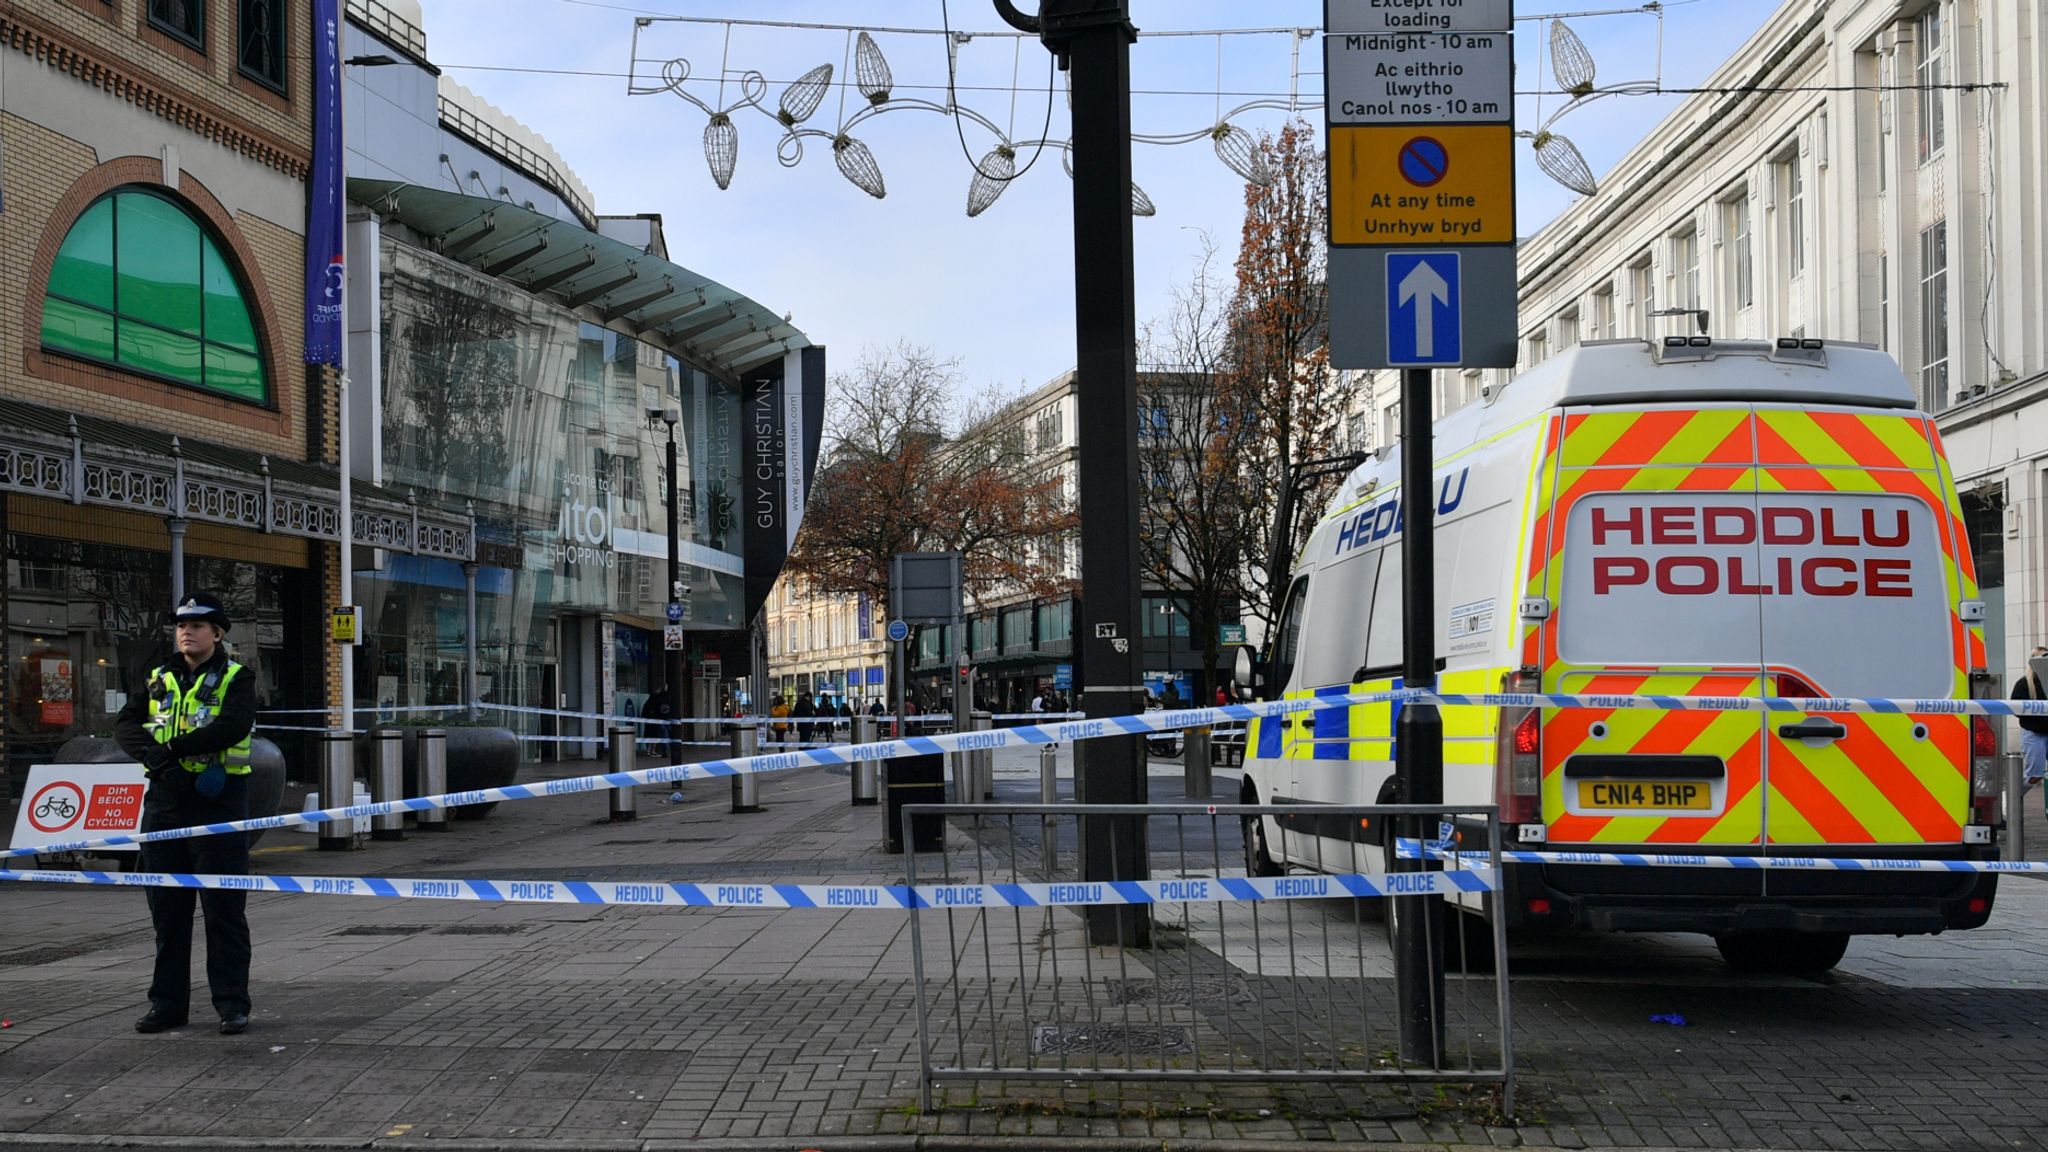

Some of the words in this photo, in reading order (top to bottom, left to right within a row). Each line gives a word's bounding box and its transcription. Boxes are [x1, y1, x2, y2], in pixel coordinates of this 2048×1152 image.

[1385, 13, 1451, 28] loading
[1346, 36, 1426, 52] Midnight
[1441, 35, 1462, 49] 10
[1466, 37, 1493, 49] am
[1375, 63, 1398, 77] Ac
[1404, 62, 1464, 77] eithrio
[1386, 81, 1453, 98] llwytho
[1341, 101, 1395, 116] Canol
[1401, 103, 1432, 115] nos
[1446, 100, 1467, 114] 10
[1472, 102, 1498, 114] am
[1371, 193, 1391, 208] At
[1398, 196, 1429, 211] any
[1436, 193, 1476, 208] time
[1364, 219, 1434, 236] Unrhyw
[1441, 218, 1481, 235] bryd
[755, 378, 773, 481] CHRISTIAN
[776, 428, 785, 478] salon
[791, 395, 800, 512] www.guychristian.com
[599, 478, 609, 491] to
[757, 489, 774, 529] GUY
[1335, 467, 1470, 556] HEDU
[1591, 506, 1911, 547] HEDDLU
[1593, 556, 1913, 597] POLICE
[1804, 699, 1852, 712] POLICE
[1914, 701, 1967, 714] HEDDLU
[443, 789, 486, 806] POLICE
[546, 777, 594, 794] HEDDLU
[646, 766, 690, 783] POLICE
[751, 754, 799, 772] HEDDLU
[852, 743, 896, 761] POLICE
[957, 732, 1006, 751] HEDDLU
[1059, 721, 1104, 740] POLICE
[1165, 711, 1214, 729] HEDDLU
[1267, 701, 1311, 719] POLICE
[107, 786, 128, 795] DIM
[1593, 784, 1646, 805] CN14
[1652, 784, 1697, 806] BHP
[97, 795, 134, 805] BEICIO
[105, 808, 122, 817] NO
[87, 818, 134, 827] CYCLING
[313, 879, 354, 894] POLICE
[412, 881, 459, 898] HEDDLU
[510, 883, 555, 900] POLICE
[615, 885, 664, 903] HEDDLU
[718, 886, 763, 904] POLICE
[827, 888, 878, 906] HEDDLU
[935, 887, 983, 905] POLICE
[1050, 884, 1101, 903] HEDDLU
[1160, 882, 1208, 900] POLICE
[1275, 878, 1328, 897] HEDDLU
[1386, 874, 1435, 893] POLICE
